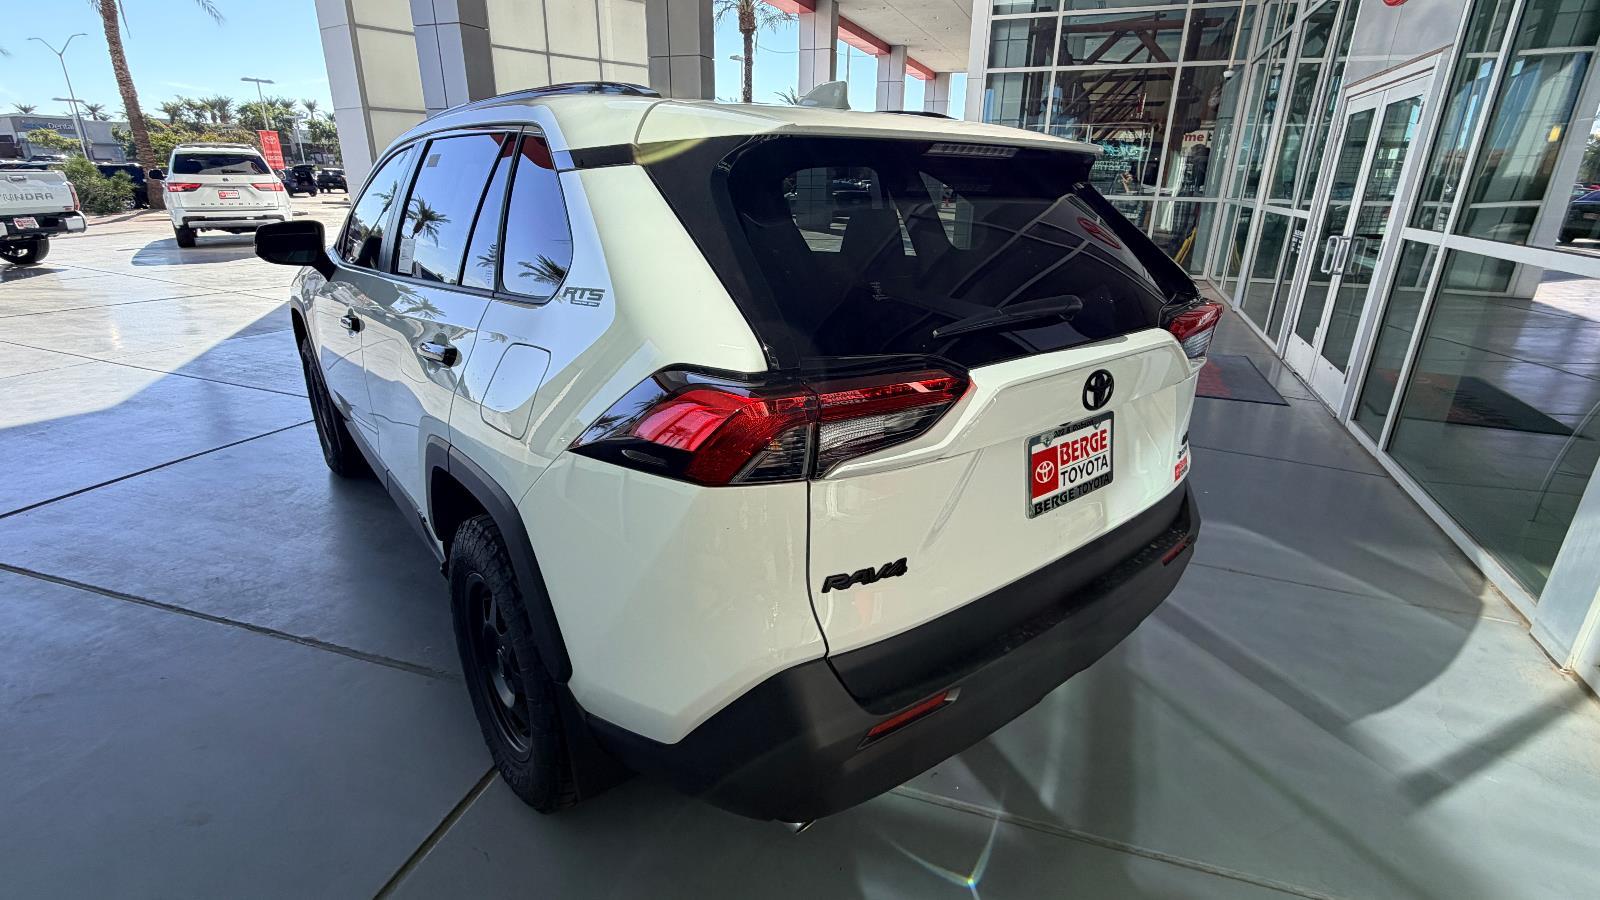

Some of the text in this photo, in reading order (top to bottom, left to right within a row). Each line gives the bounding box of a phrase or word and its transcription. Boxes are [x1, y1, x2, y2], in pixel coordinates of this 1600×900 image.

[562, 287, 605, 302] RTS
[1059, 429, 1107, 466] BERGE
[1060, 454, 1108, 486] TOYOTA
[1034, 474, 1109, 515] BERGE TOYOTA
[821, 556, 908, 593] RAV4
